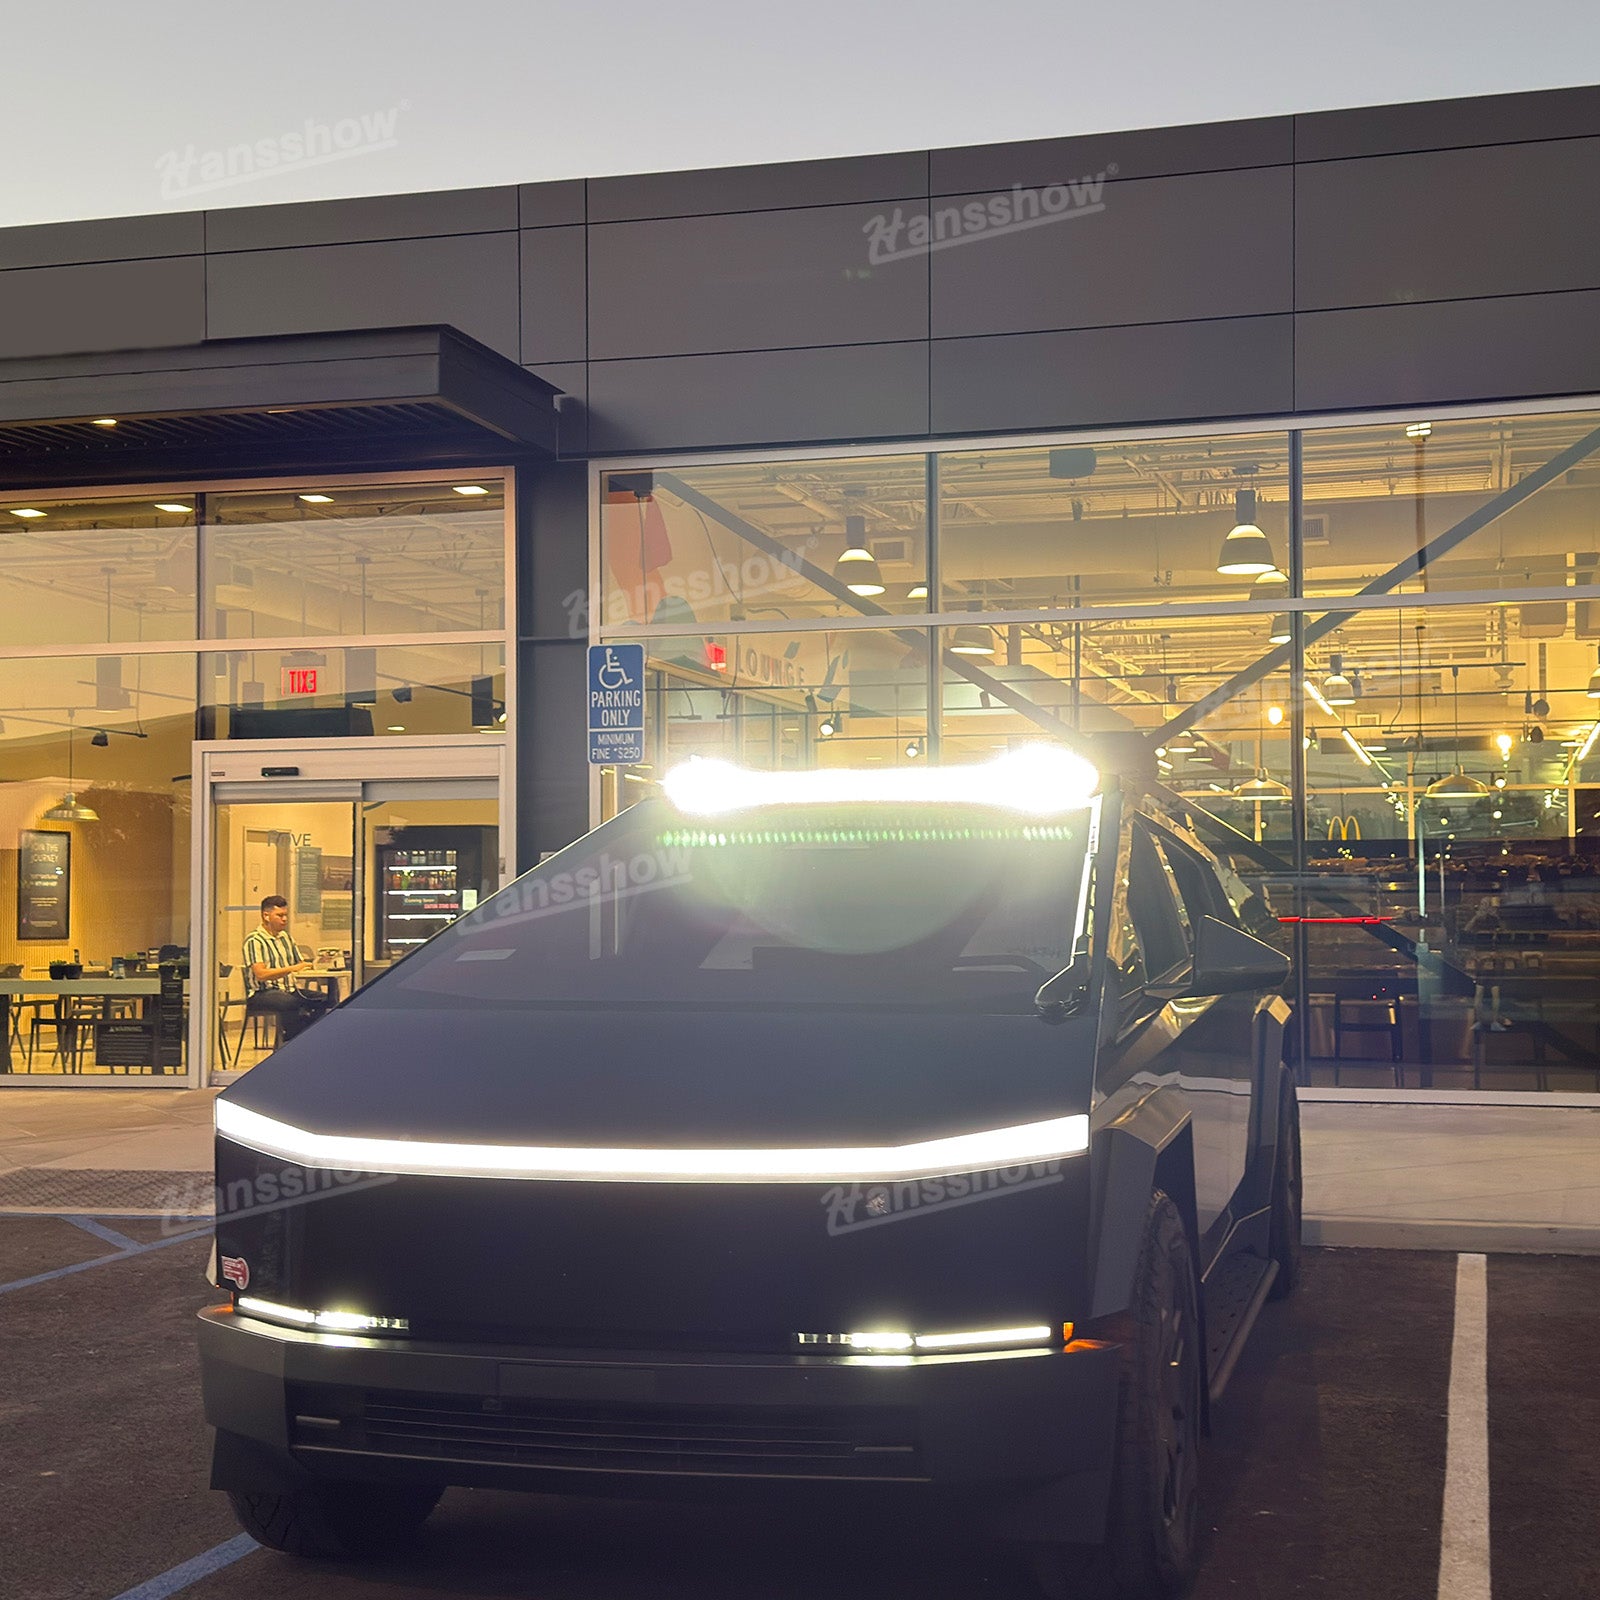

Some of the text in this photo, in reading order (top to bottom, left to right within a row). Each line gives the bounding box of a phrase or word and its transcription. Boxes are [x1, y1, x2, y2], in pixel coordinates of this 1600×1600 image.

[591, 690, 641, 707] PARKING
[601, 709, 631, 726] ONLY
[597, 733, 635, 745] MINIMUM
[591, 748, 611, 759] FINE
